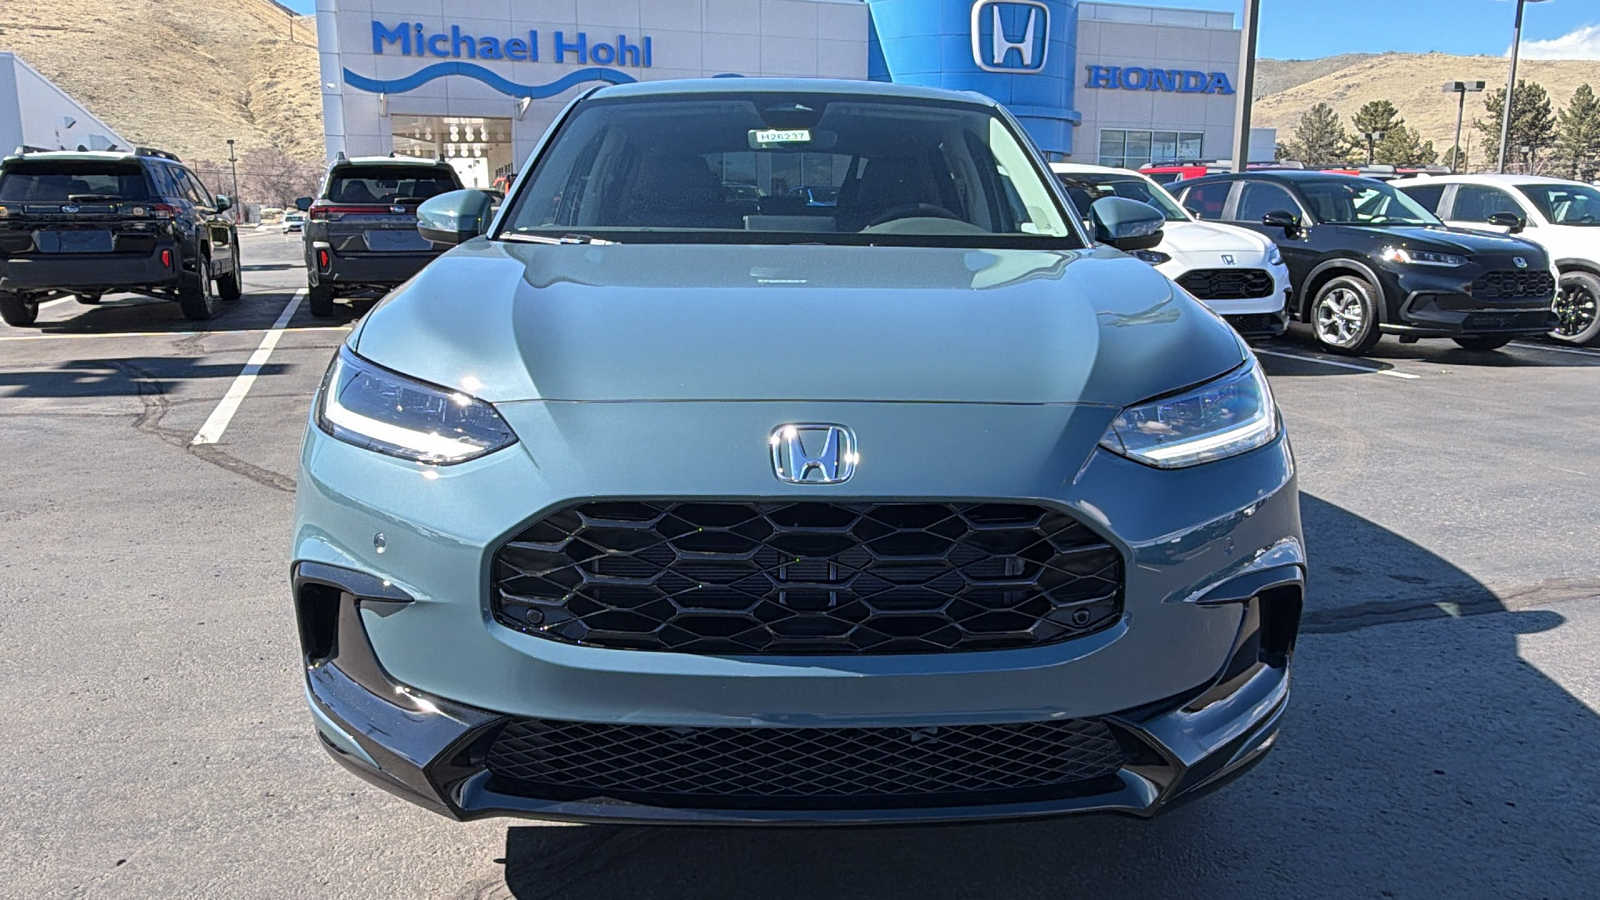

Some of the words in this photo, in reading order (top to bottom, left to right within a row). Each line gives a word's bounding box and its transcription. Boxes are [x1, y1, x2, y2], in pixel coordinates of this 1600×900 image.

[372, 20, 539, 62] Michael
[553, 31, 652, 67] Hohl
[1085, 64, 1235, 95] HONDA
[761, 132, 805, 141] H26237
